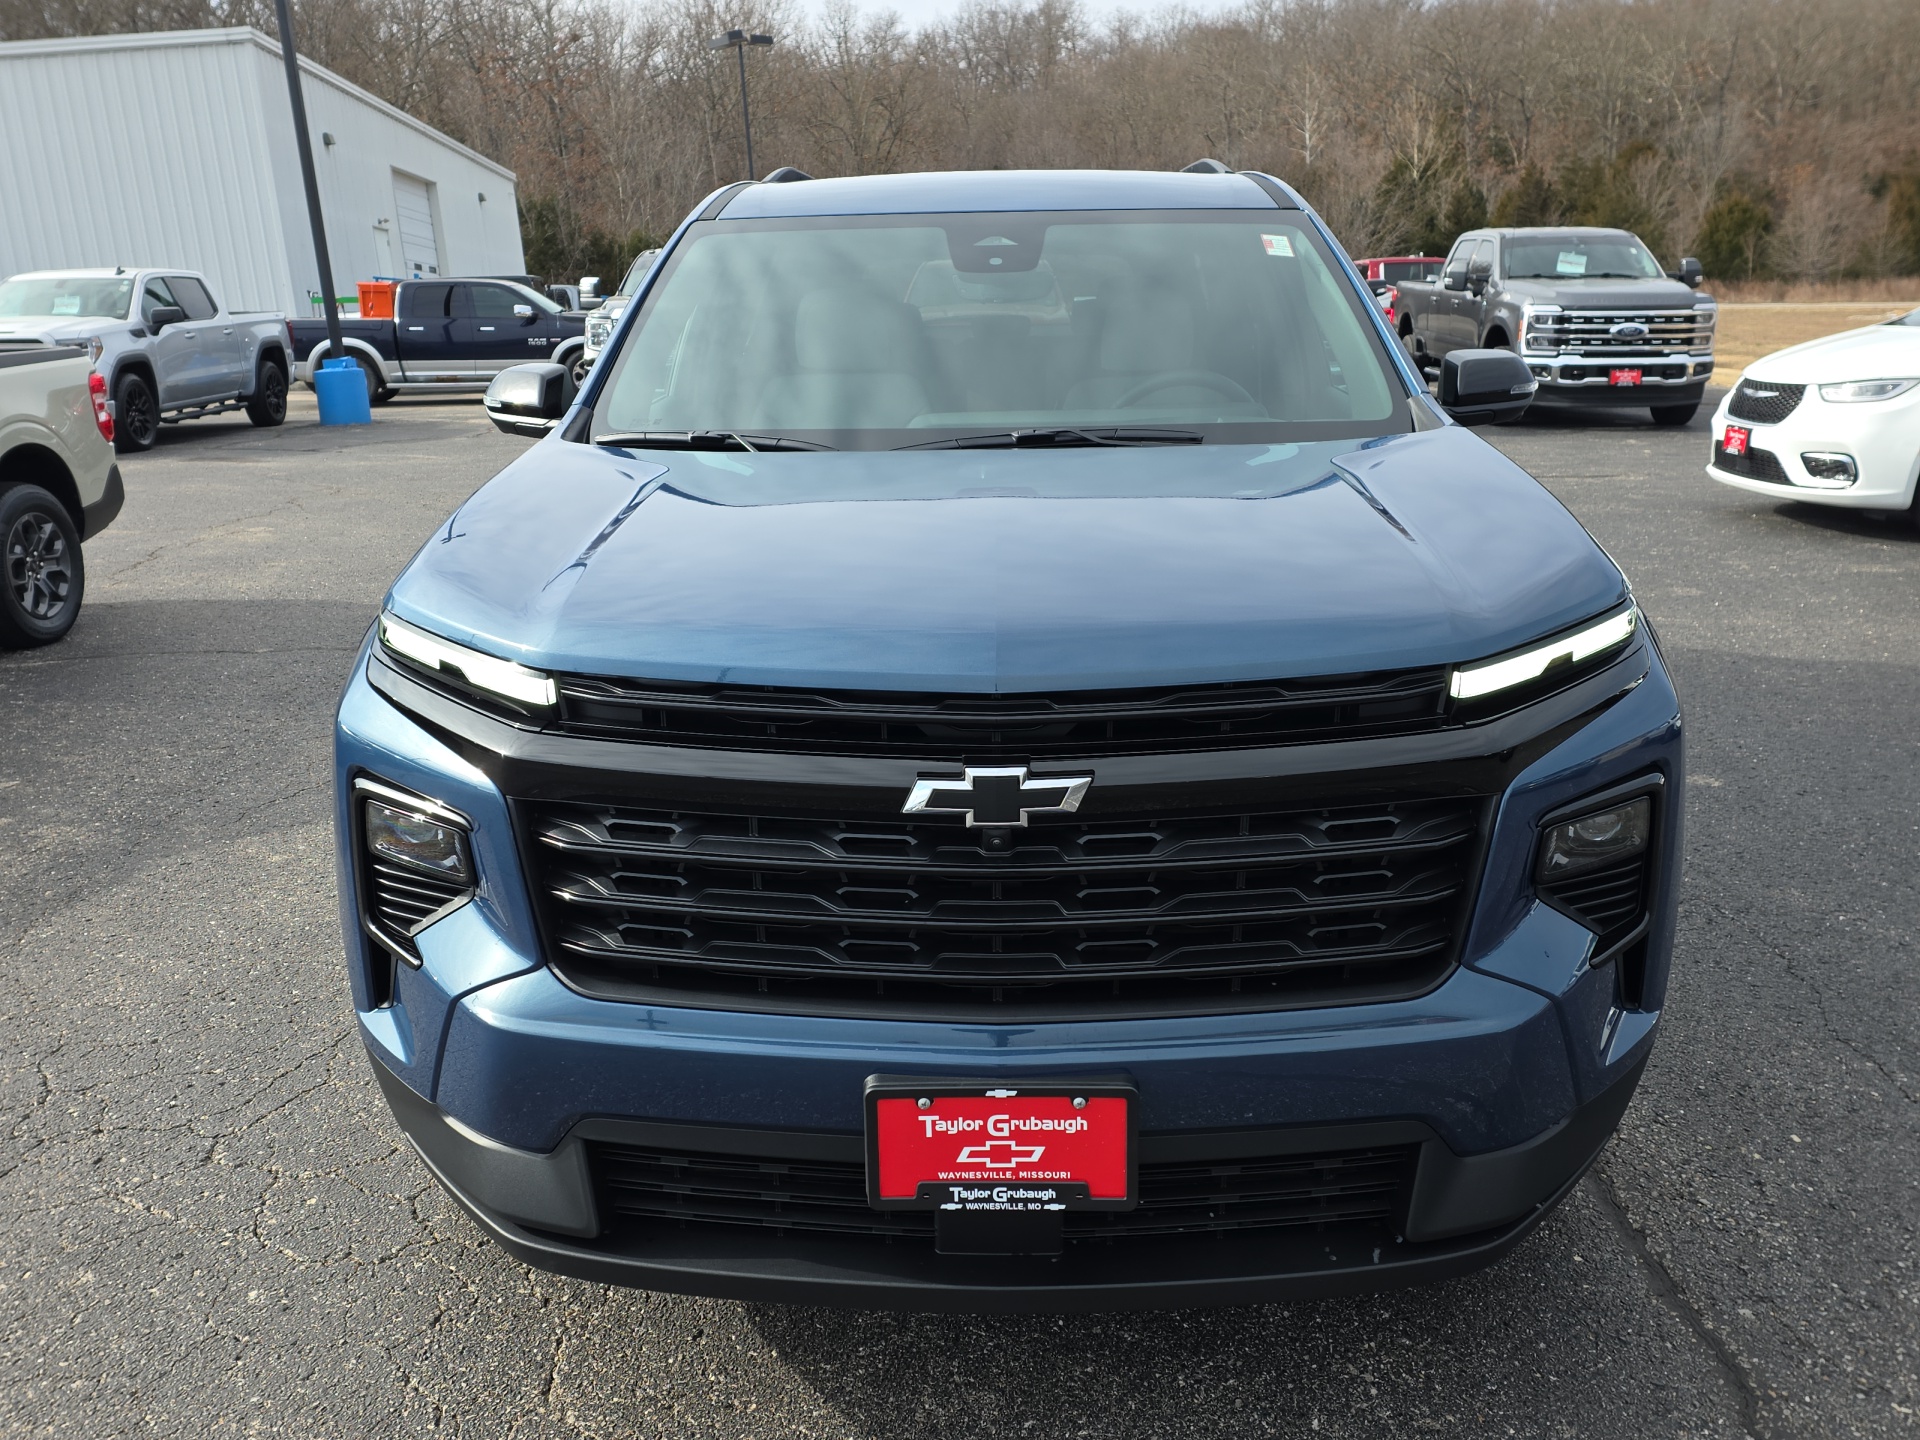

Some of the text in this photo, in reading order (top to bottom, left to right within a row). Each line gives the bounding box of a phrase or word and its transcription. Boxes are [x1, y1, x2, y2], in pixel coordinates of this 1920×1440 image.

[918, 1114, 1088, 1138] Taylor Grubaugh
[938, 1171, 1071, 1180] WAYNESVILLE, MISSOURI
[949, 1186, 1056, 1202] Taylor Grubaugh
[965, 1203, 1026, 1211] WAYNESVILLE,
